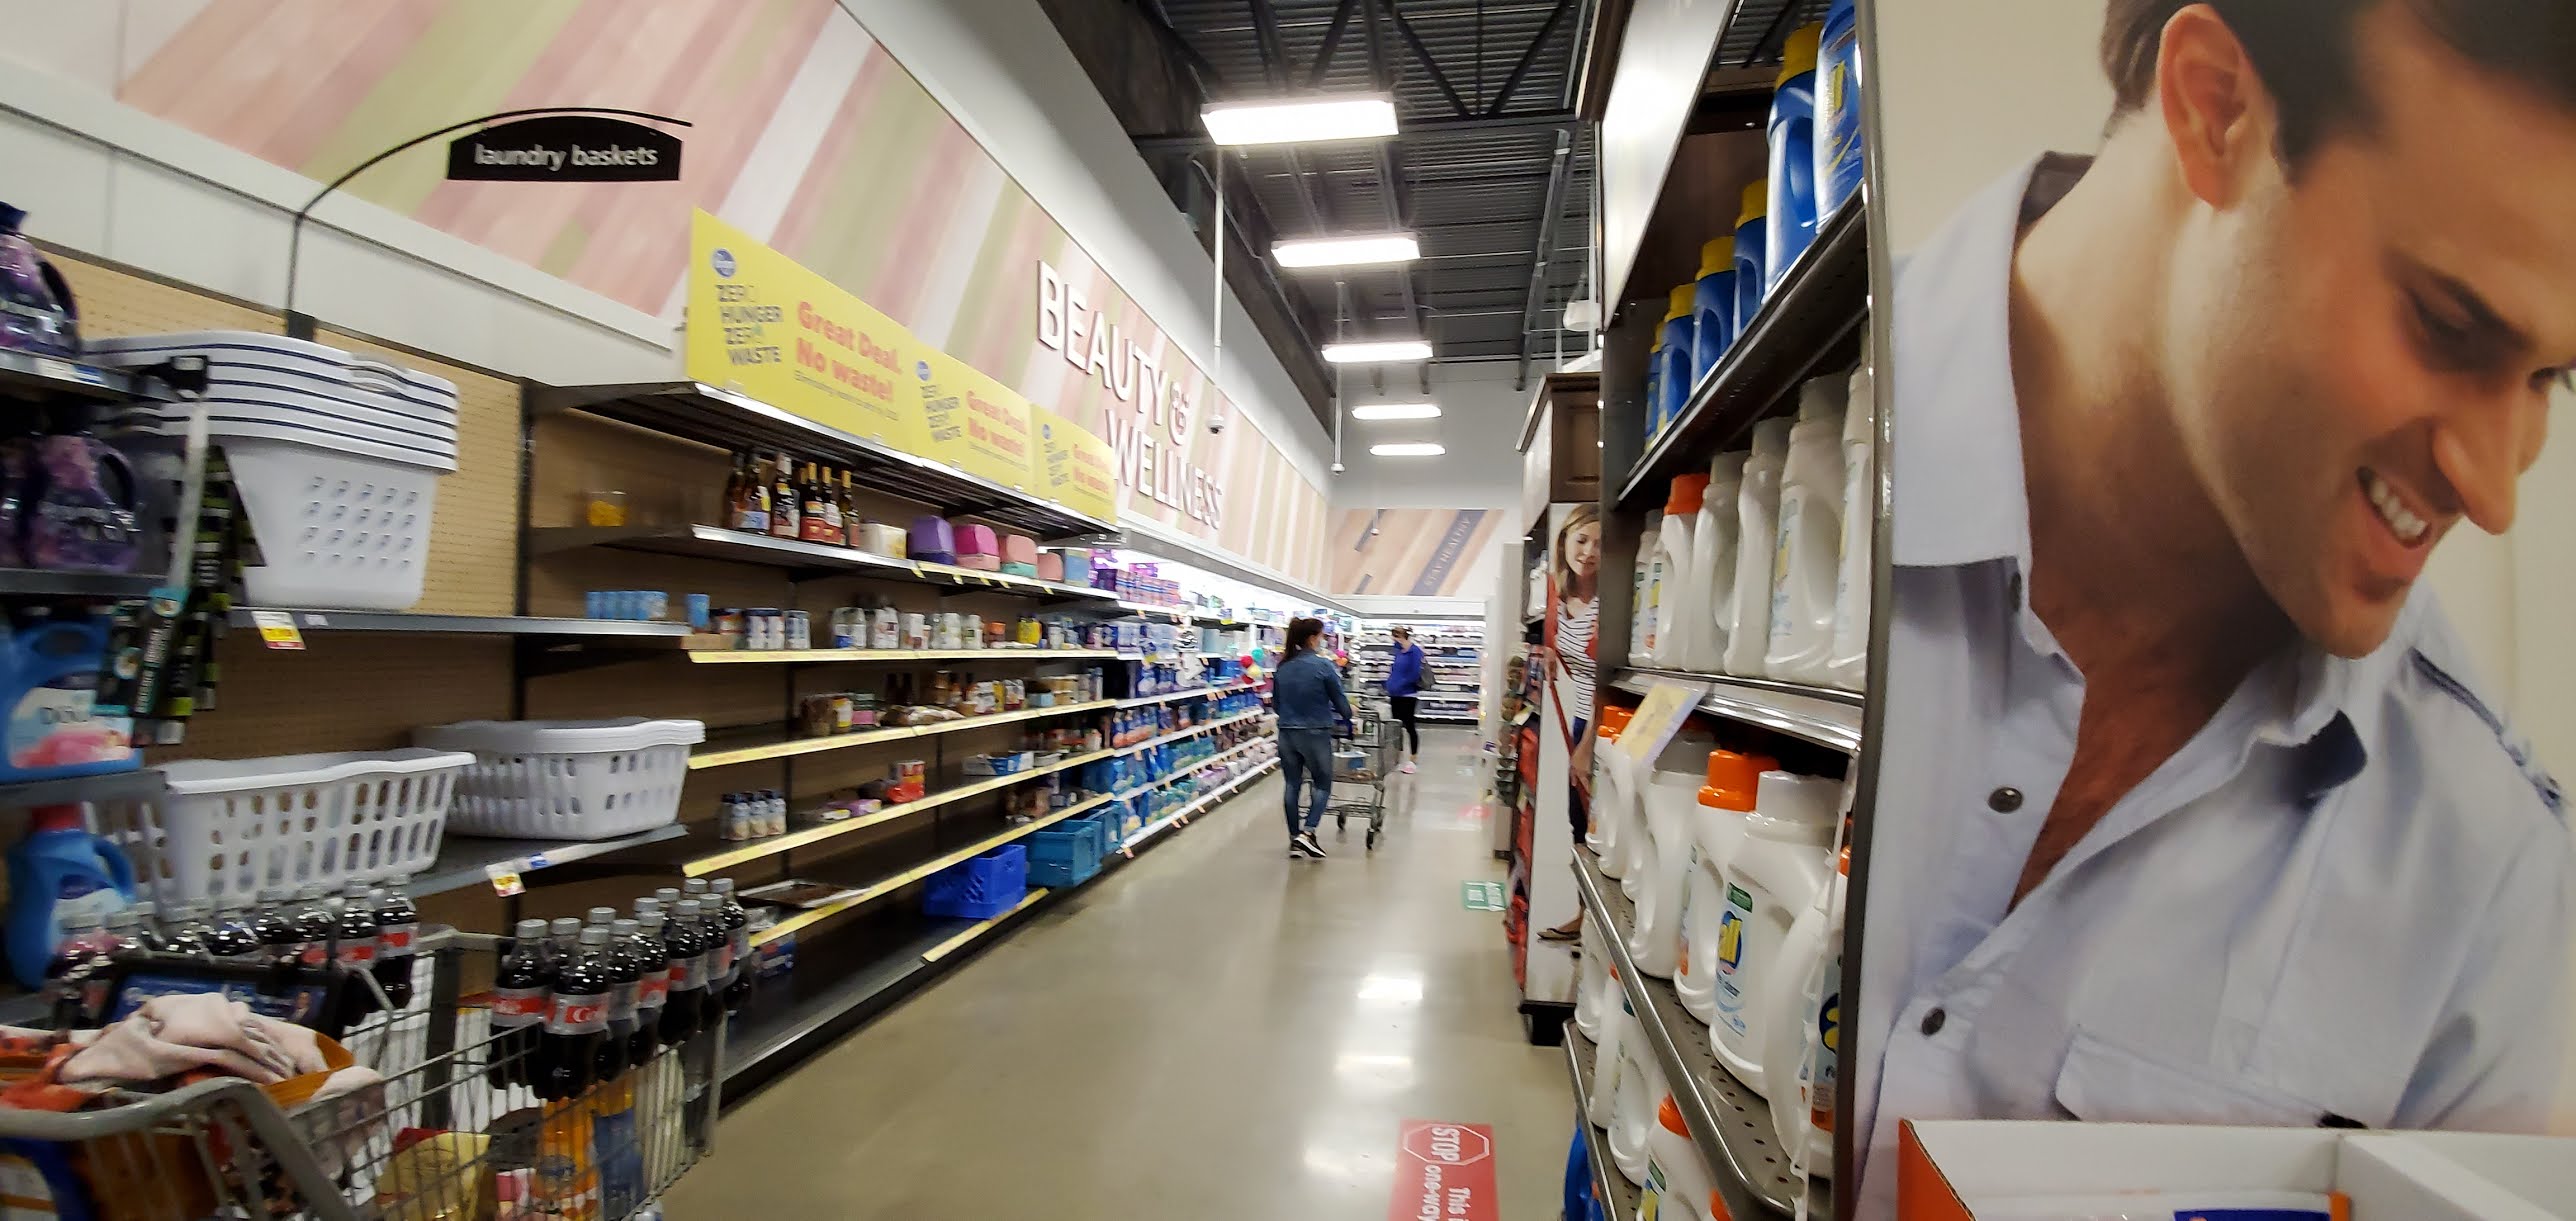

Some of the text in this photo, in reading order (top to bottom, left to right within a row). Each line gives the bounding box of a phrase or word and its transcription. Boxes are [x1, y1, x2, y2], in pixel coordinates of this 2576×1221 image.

[474, 143, 660, 172] laundry baskets
[719, 305, 784, 325] HUNGER
[797, 301, 854, 351] Great
[727, 346, 783, 366] WASTE
[796, 337, 828, 373] No
[1037, 259, 1169, 427] BEAUTY
[1168, 379, 1190, 446] &
[1105, 408, 1223, 530] WELLNESS
[1431, 1126, 1460, 1161] STOP
[1447, 1187, 1472, 1215] This
